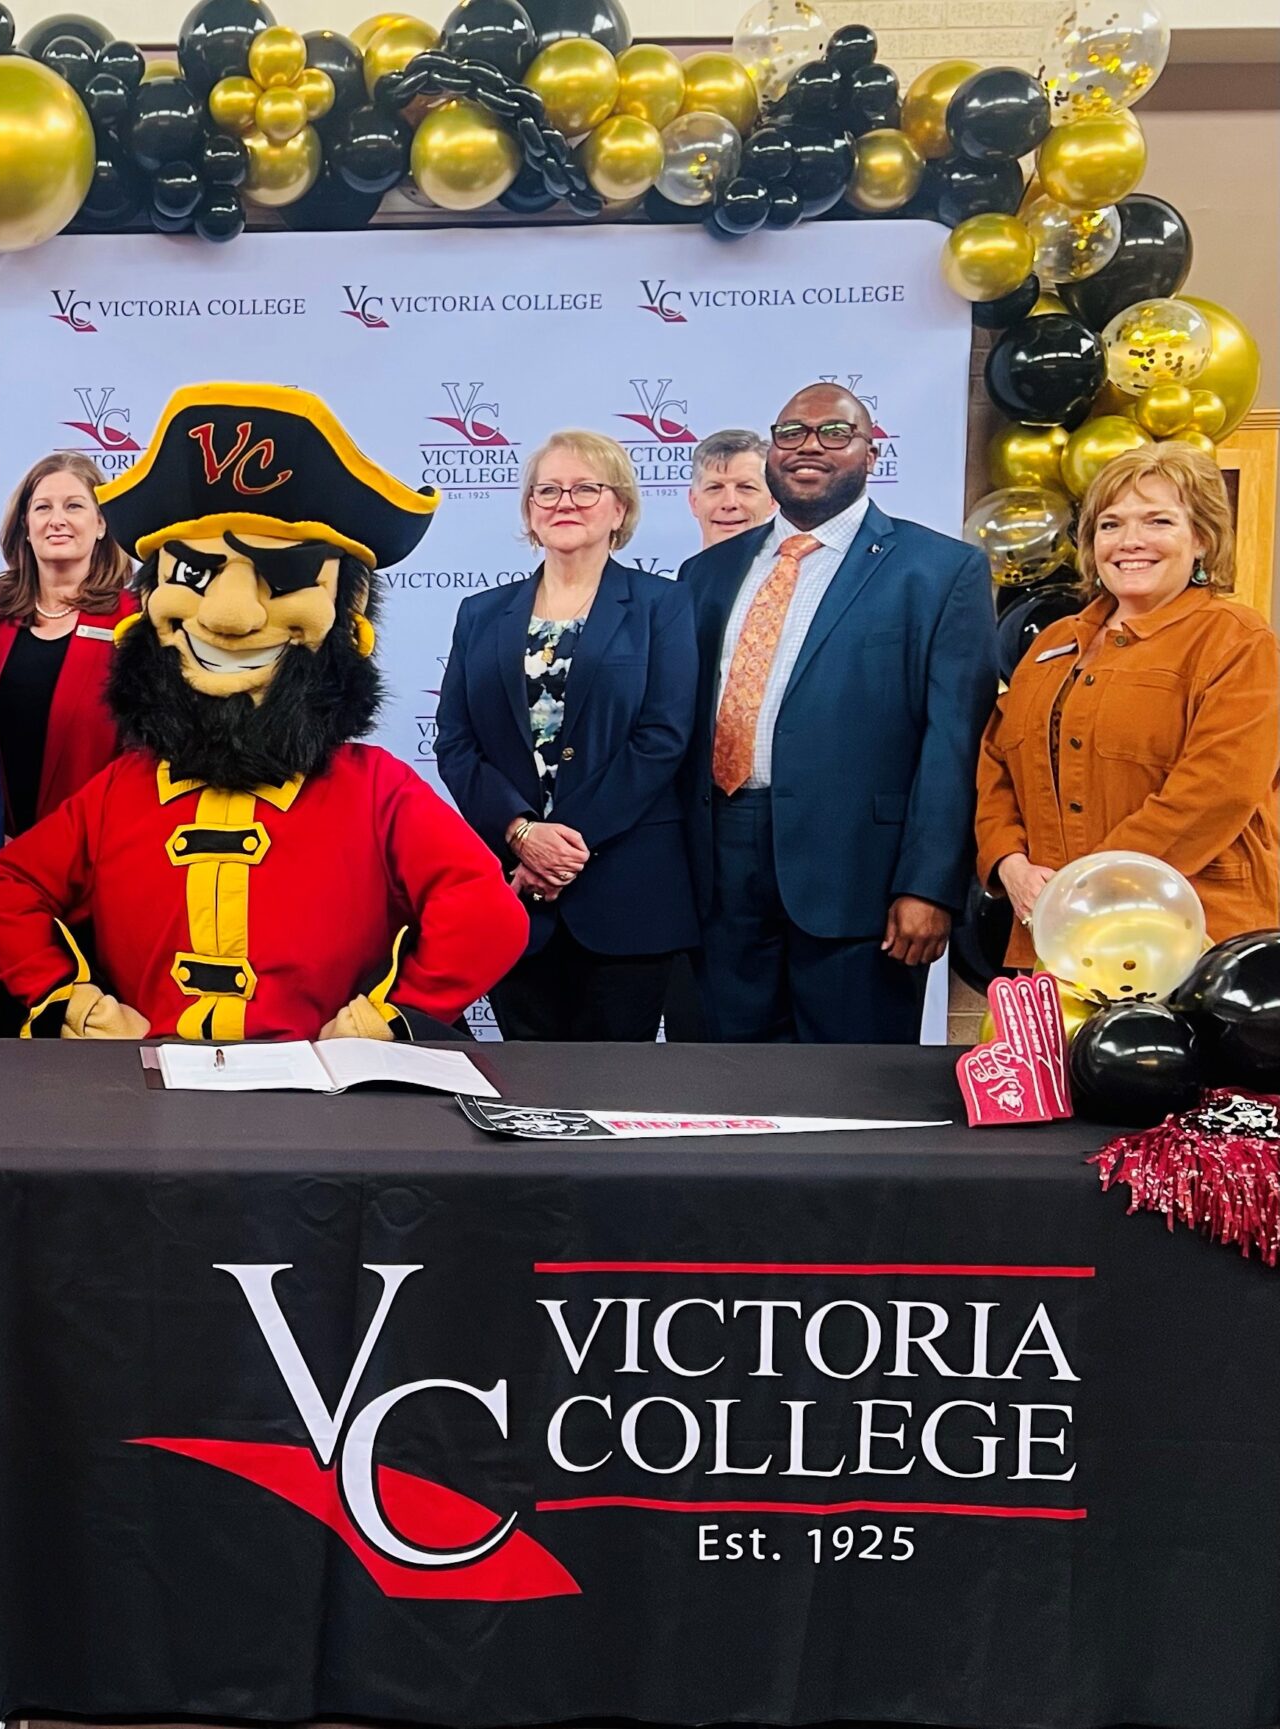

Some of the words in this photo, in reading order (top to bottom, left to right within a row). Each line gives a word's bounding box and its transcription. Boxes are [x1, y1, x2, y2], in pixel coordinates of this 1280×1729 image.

[390, 295, 496, 313] VICTORIA
[501, 292, 603, 312] COLLEGE
[688, 288, 793, 308] VICTORIA
[799, 284, 905, 306] COLLEGE
[98, 299, 202, 317] VICTORIA
[207, 298, 306, 316] COLLEGE
[188, 422, 293, 494] VC
[421, 449, 519, 465] VICTORIA
[422, 467, 520, 484] COLLEGE
[468, 491, 490, 499] 1925
[385, 572, 490, 588] VICTORIA
[535, 1297, 1082, 1382] VICTORIA
[212, 1263, 518, 1567] VC
[546, 1394, 1080, 1482] COLLEGE
[698, 1524, 783, 1562] Est.
[806, 1526, 916, 1564] 1925
